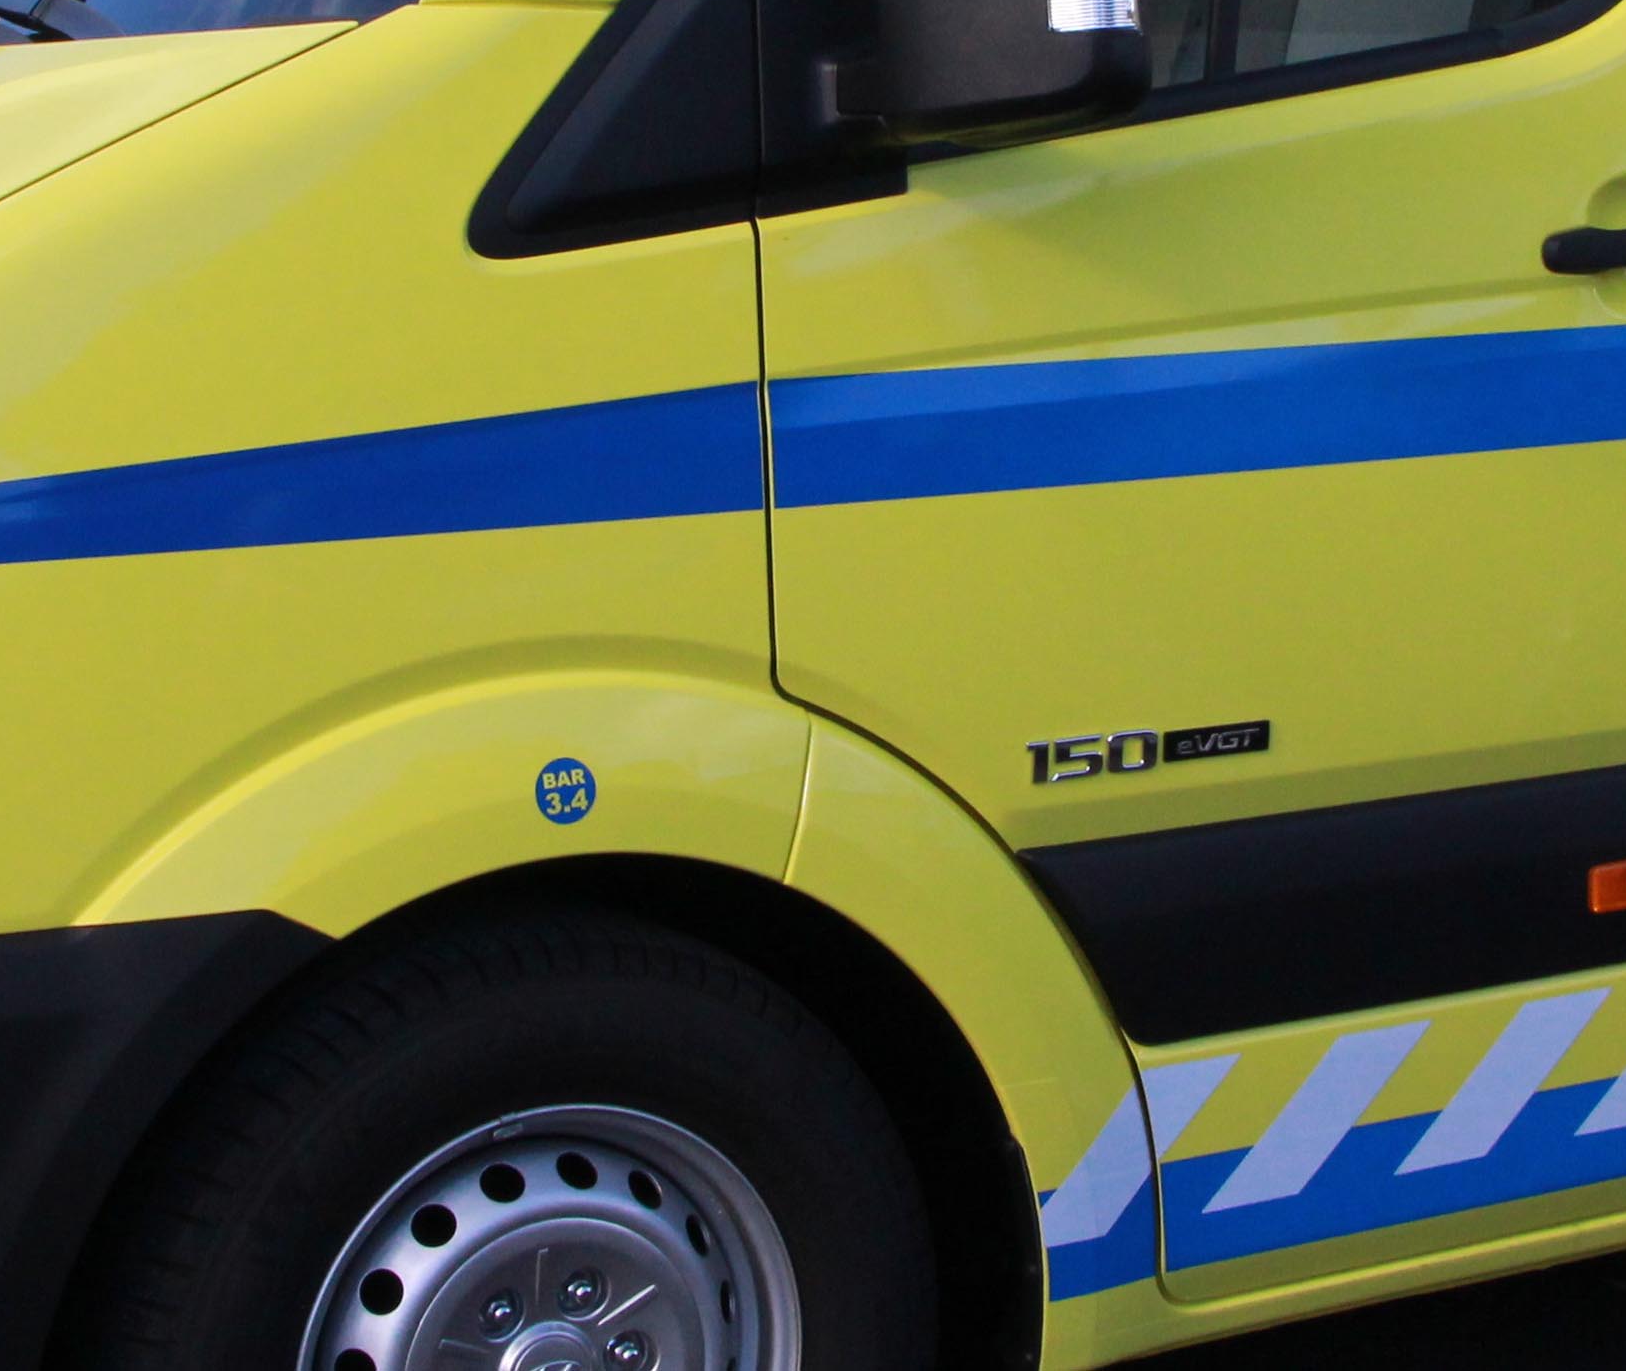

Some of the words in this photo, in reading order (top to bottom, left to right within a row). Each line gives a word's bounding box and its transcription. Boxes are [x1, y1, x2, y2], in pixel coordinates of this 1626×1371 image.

[1026, 728, 1158, 783] 150
[1177, 727, 1260, 755] eVGT
[542, 768, 586, 789] BAR
[545, 788, 588, 815] 3.4
